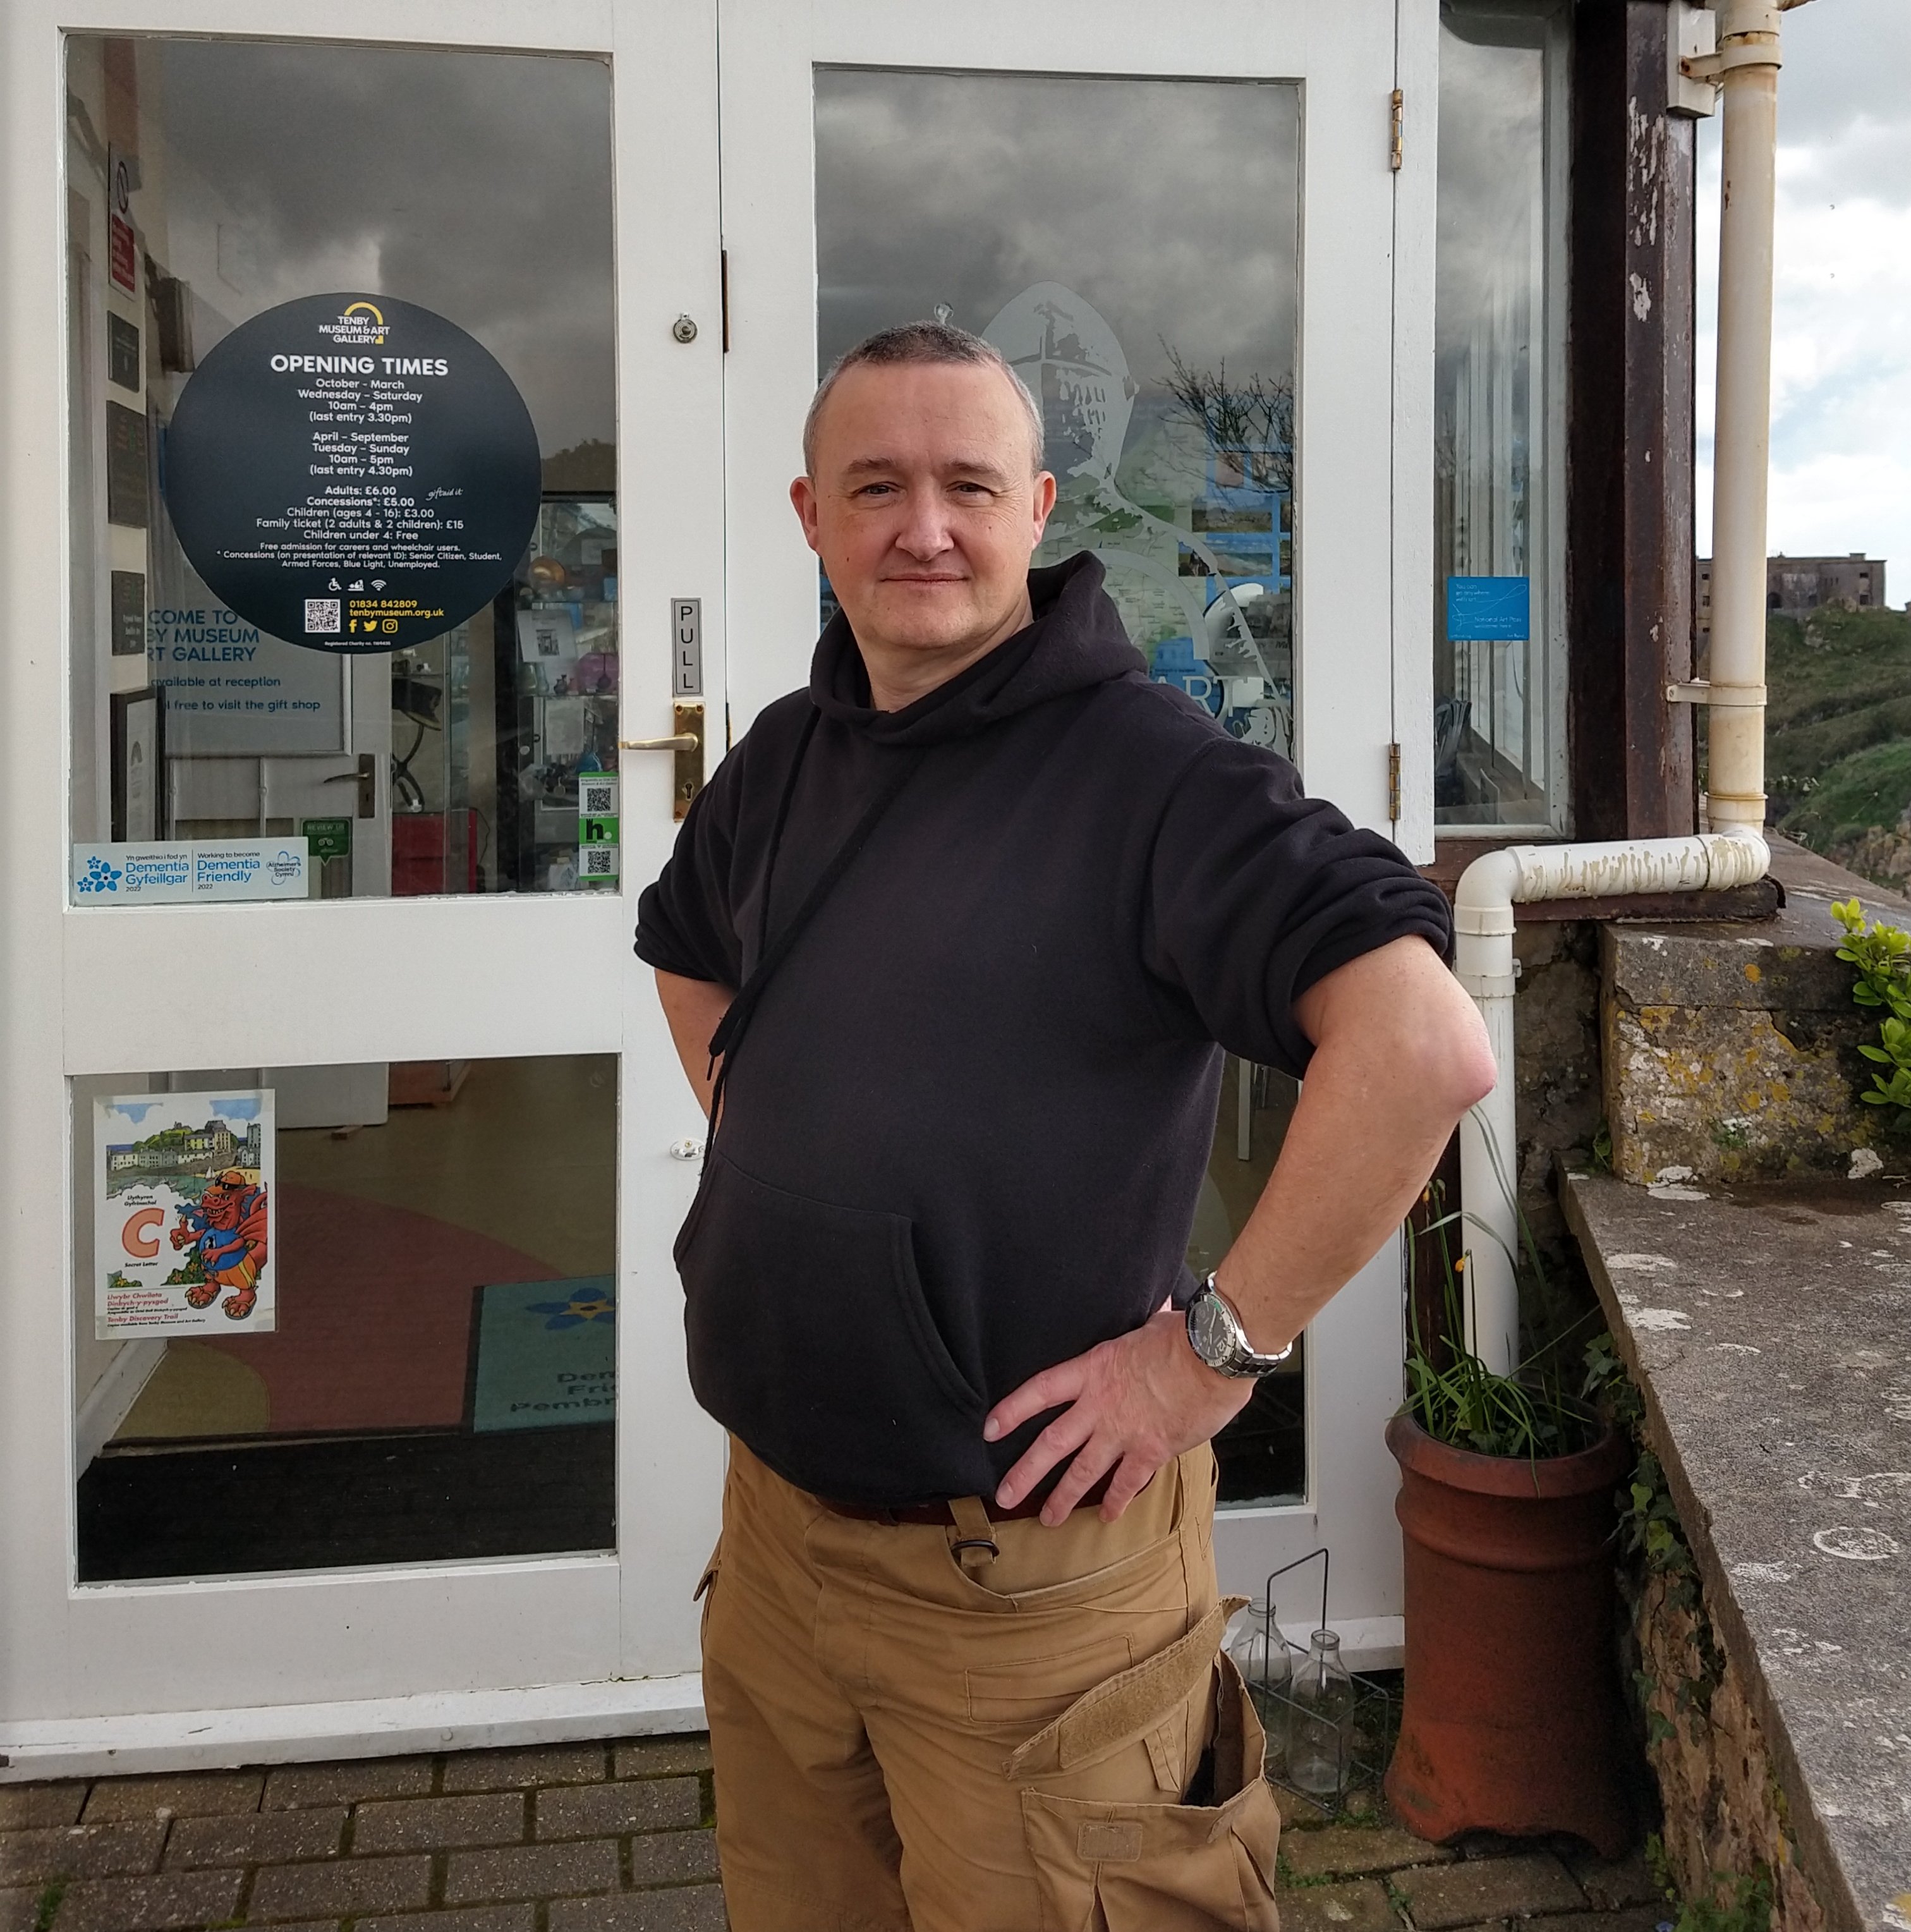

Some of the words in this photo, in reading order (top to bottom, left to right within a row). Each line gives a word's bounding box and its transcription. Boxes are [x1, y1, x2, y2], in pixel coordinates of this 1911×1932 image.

[337, 316, 369, 325] TENBY
[319, 325, 361, 334] MUSEUM
[333, 334, 376, 343] GALLERY
[271, 355, 374, 374] OPENING
[382, 358, 448, 375] TIMES
[316, 379, 360, 388] October
[371, 380, 404, 389] March
[298, 389, 361, 401] Wednesday
[373, 391, 422, 403] Saturday
[328, 401, 356, 410] 10am
[369, 402, 393, 413] 4pm
[310, 411, 333, 422] (last
[337, 413, 365, 424] entry
[368, 413, 411, 425] 3.30pm)
[313, 432, 338, 443] April
[351, 432, 408, 444] September
[312, 443, 357, 454] Tuesday
[370, 444, 410, 456] Sunday
[329, 454, 358, 463] 10am
[370, 455, 394, 466] 5pm
[310, 465, 334, 475] (last
[337, 466, 365, 477] entry
[368, 466, 412, 477] 4.30pm)
[325, 486, 361, 495] Adults:
[365, 486, 396, 495] £6.00
[384, 497, 414, 506] £5.00
[288, 507, 329, 516] Children
[333, 507, 361, 519] (ages
[384, 508, 401, 518] 16):
[404, 509, 434, 518] £3.00
[257, 518, 289, 530] Family
[293, 519, 321, 528] ticket
[325, 518, 335, 529] (2
[339, 519, 371, 528] adults
[375, 519, 382, 528] &
[387, 519, 393, 528] 2
[397, 519, 442, 530] children):
[447, 520, 463, 529] £15
[304, 530, 346, 538] Children
[349, 530, 379, 539] under
[396, 531, 418, 539] Free
[277, 550, 290, 559] (on
[293, 552, 345, 560] presentation
[394, 552, 406, 560] ID):
[363, 561, 385, 569] Light,
[389, 561, 440, 569] Unemployed.
[212, 610, 238, 624] TO
[349, 609, 444, 618] tenbymuseum.org.uk
[174, 629, 260, 643] MUSEUM
[681, 606, 694, 688] PULL
[173, 647, 256, 661] GALLERY
[209, 677, 221, 686] at
[226, 677, 281, 689] reception
[1155, 676, 1247, 717] RT
[174, 700, 198, 710] free
[203, 701, 214, 710] to
[218, 700, 241, 710] visit
[245, 700, 264, 710] the
[268, 700, 288, 712] gift
[292, 700, 321, 712] shop
[126, 861, 189, 873] Dementia
[197, 859, 260, 870] Dementia
[126, 873, 188, 886] Gyfeillgar
[197, 871, 252, 883] Friendly
[121, 1207, 165, 1258] C
